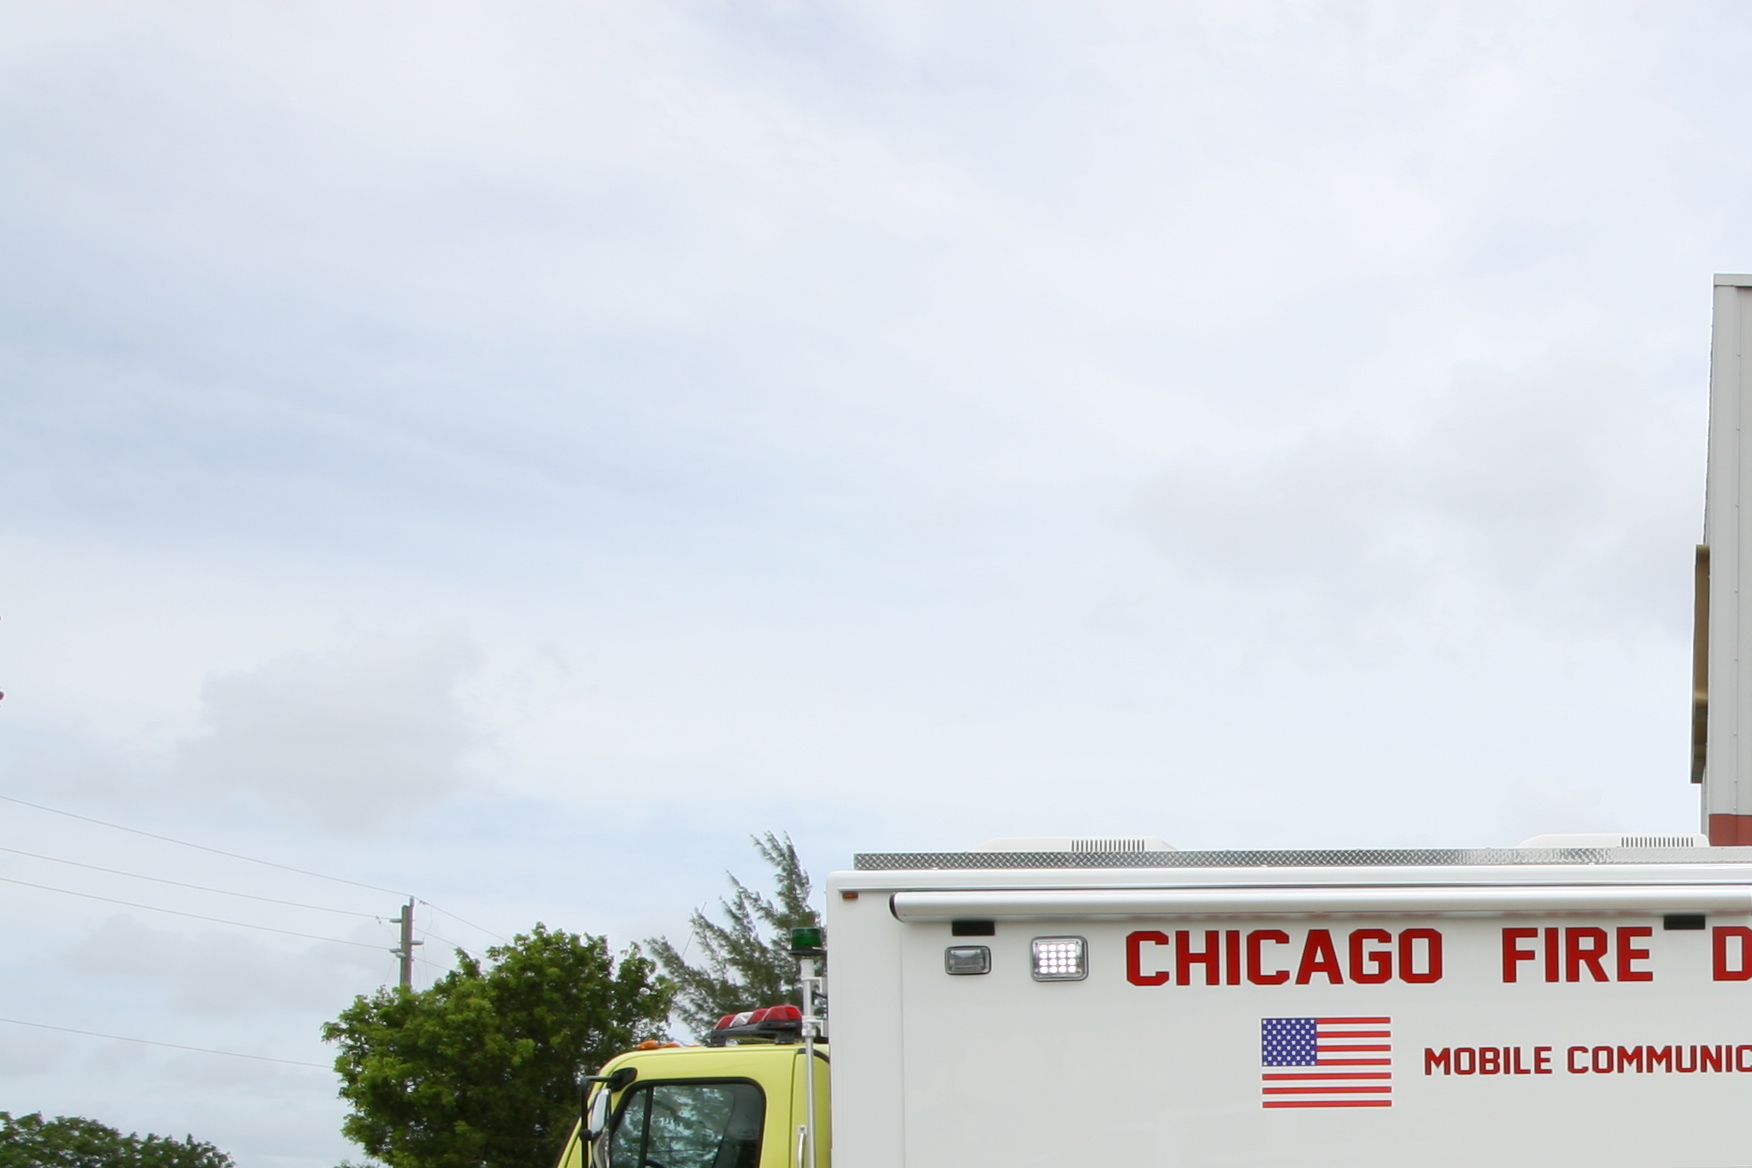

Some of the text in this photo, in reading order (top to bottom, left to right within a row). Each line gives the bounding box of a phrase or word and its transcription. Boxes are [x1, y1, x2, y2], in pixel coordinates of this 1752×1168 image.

[1127, 928, 1443, 986] CHICAGO
[1503, 927, 1653, 984] FIRE
[1425, 1046, 1553, 1076] MOBILE
